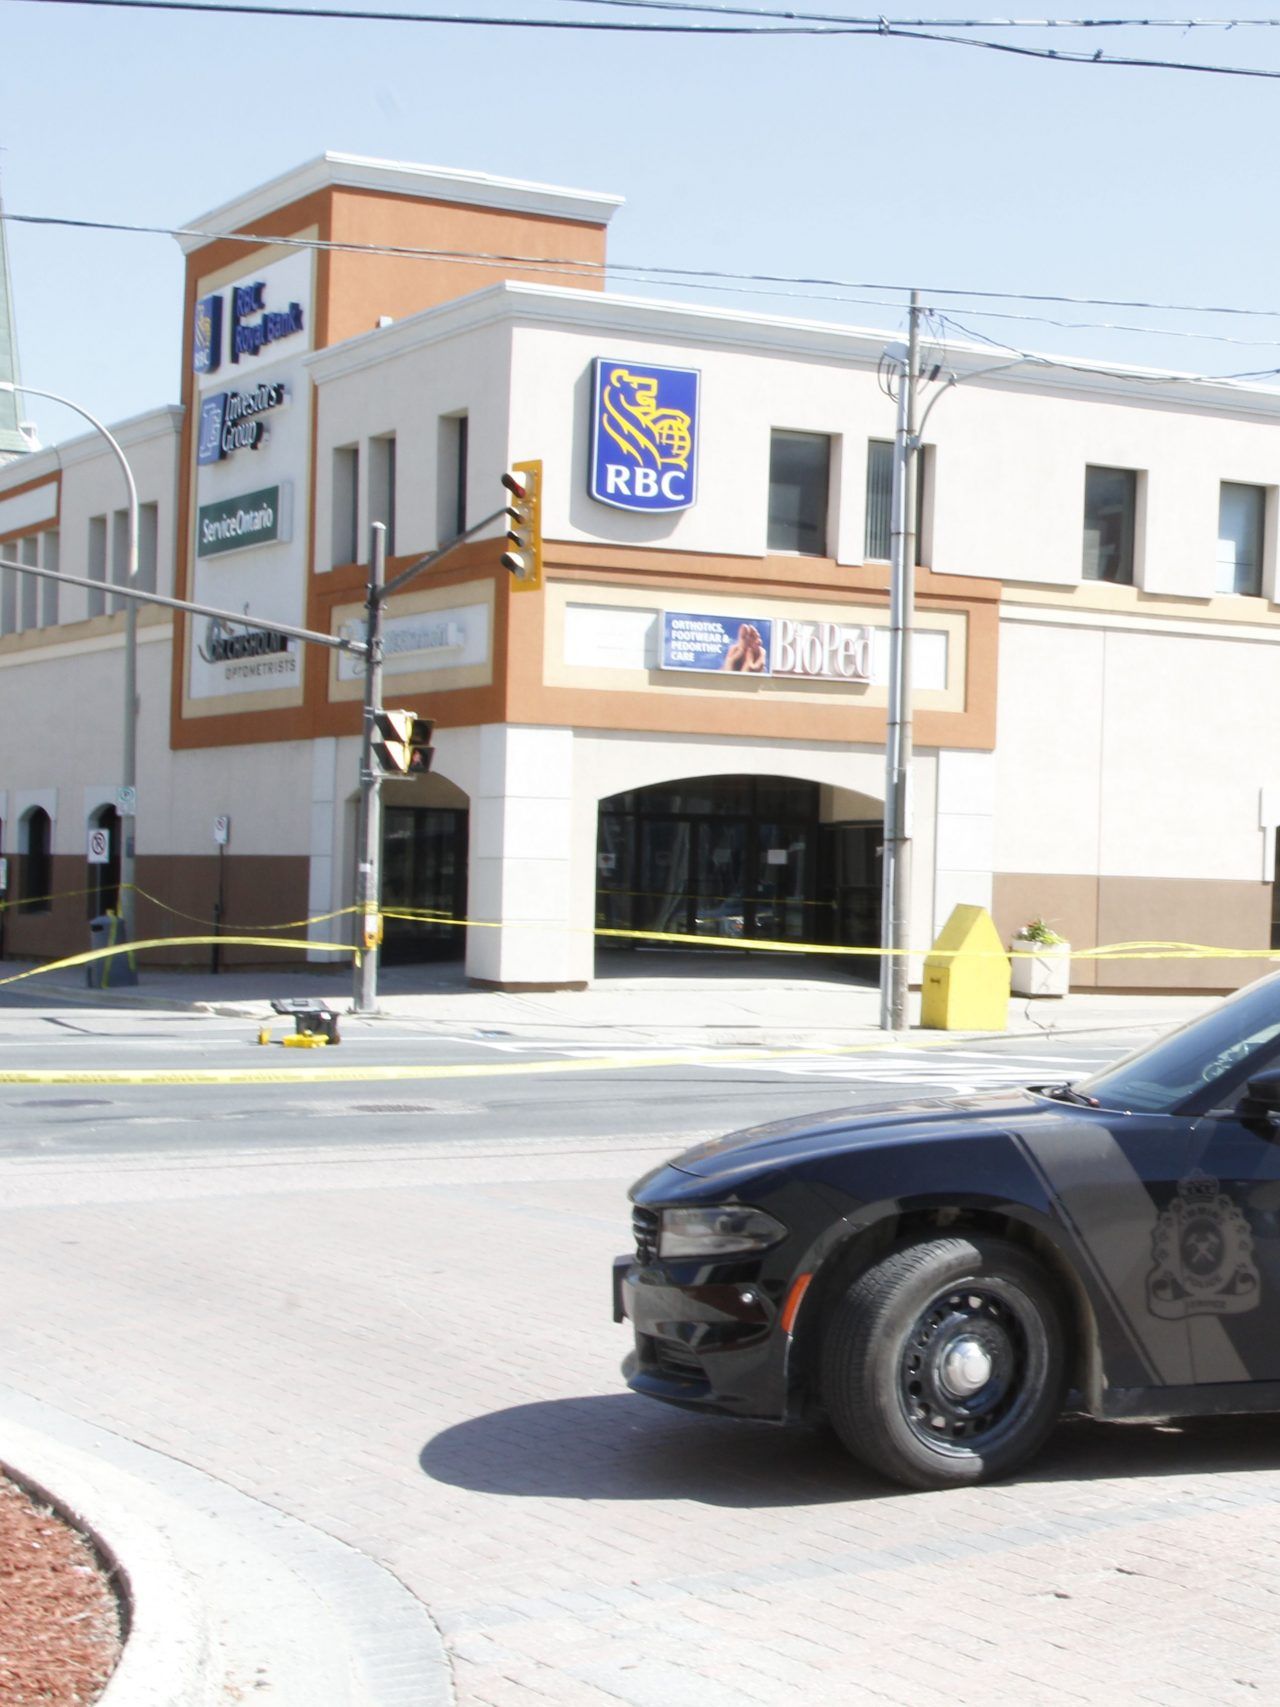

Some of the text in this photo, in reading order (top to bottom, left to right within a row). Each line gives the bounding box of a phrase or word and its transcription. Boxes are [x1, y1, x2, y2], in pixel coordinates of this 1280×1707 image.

[222, 421, 262, 453] Group
[605, 463, 686, 501] RBC
[203, 502, 274, 544] ServiceOntario
[672, 619, 725, 634] ORTHOTICS,
[672, 630, 722, 643] FOOTWEAR
[671, 651, 695, 662] CARE
[672, 640, 722, 654] PEDORTHIC
[776, 619, 875, 678] BioPed
[225, 658, 296, 681] OPTOMETRISTS
